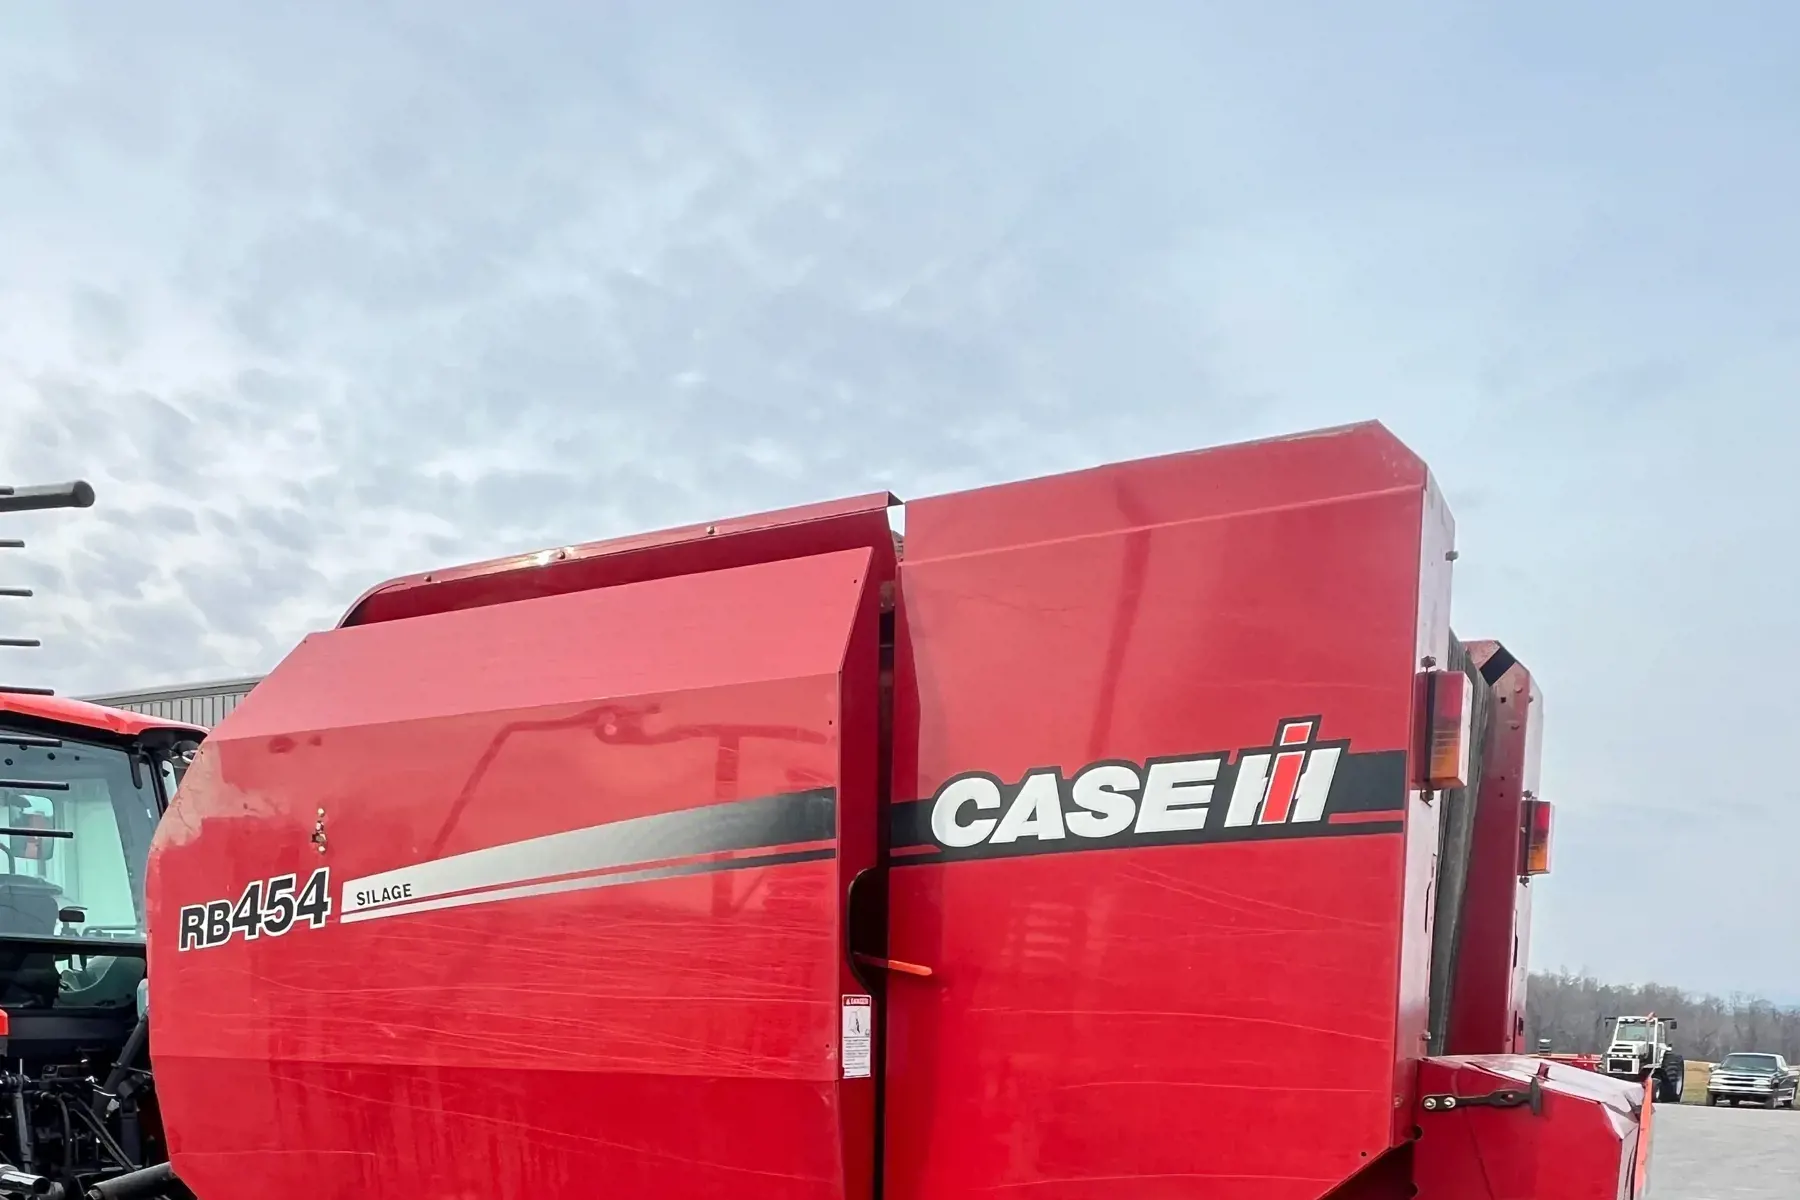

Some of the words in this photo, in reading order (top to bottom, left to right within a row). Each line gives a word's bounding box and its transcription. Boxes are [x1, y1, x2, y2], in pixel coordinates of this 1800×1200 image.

[930, 758, 1222, 848] CASE
[1223, 720, 1342, 829] IH
[179, 867, 331, 952] RB454
[355, 883, 413, 907] SILAGE
